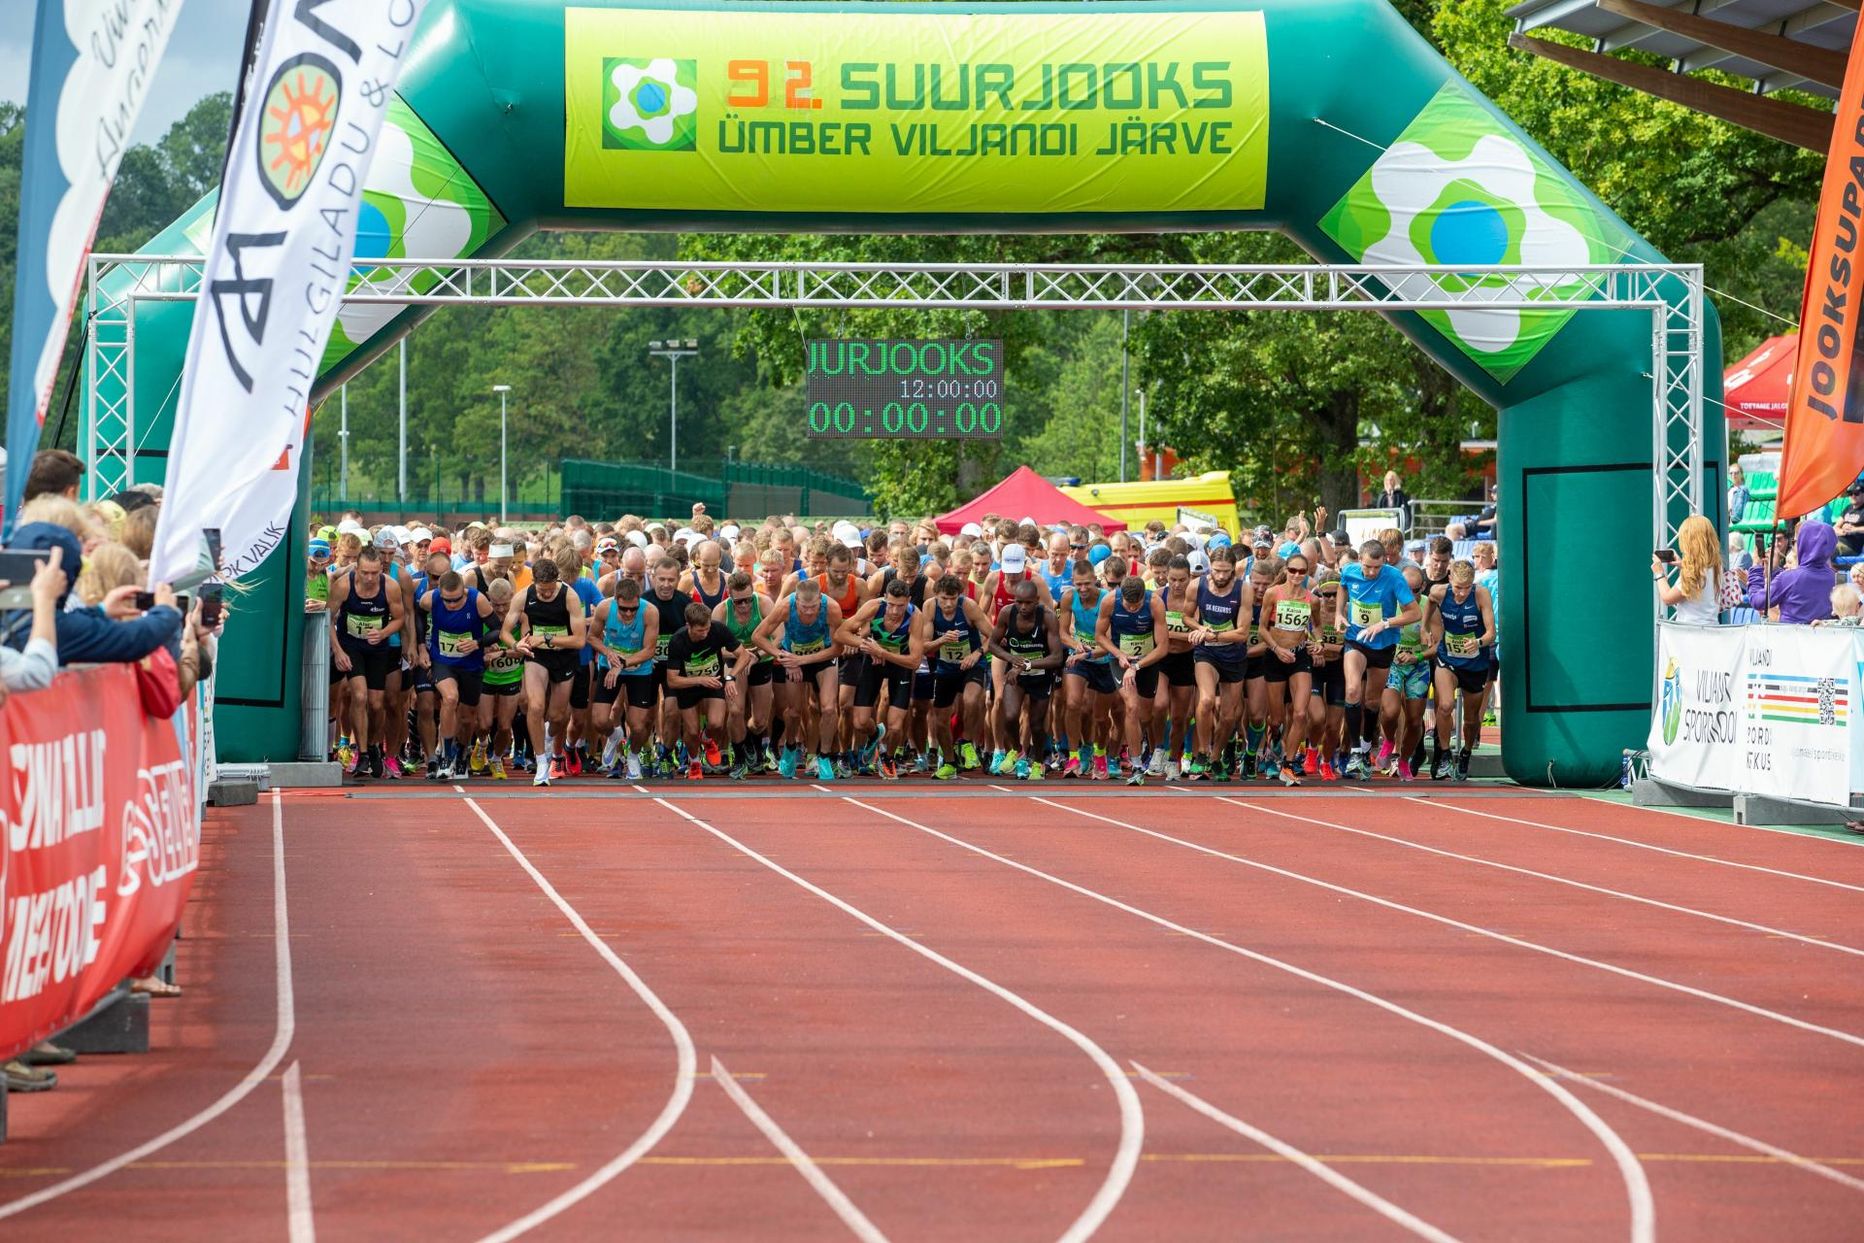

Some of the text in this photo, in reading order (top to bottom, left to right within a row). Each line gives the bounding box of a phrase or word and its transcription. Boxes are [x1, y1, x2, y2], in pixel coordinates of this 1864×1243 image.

[726, 60, 1233, 111] 92. SUURJOOKS
[718, 113, 1233, 157] ÜMBER VILJANDI JÄRVE
[901, 379, 997, 399] 12:00:00
[808, 402, 1001, 433] 00:00:00
[242, 520, 286, 565] VALIK
[1277, 613, 1309, 626] 1562
[1361, 613, 1370, 624] 9
[946, 651, 964, 661] 12
[1133, 645, 1143, 656] 2
